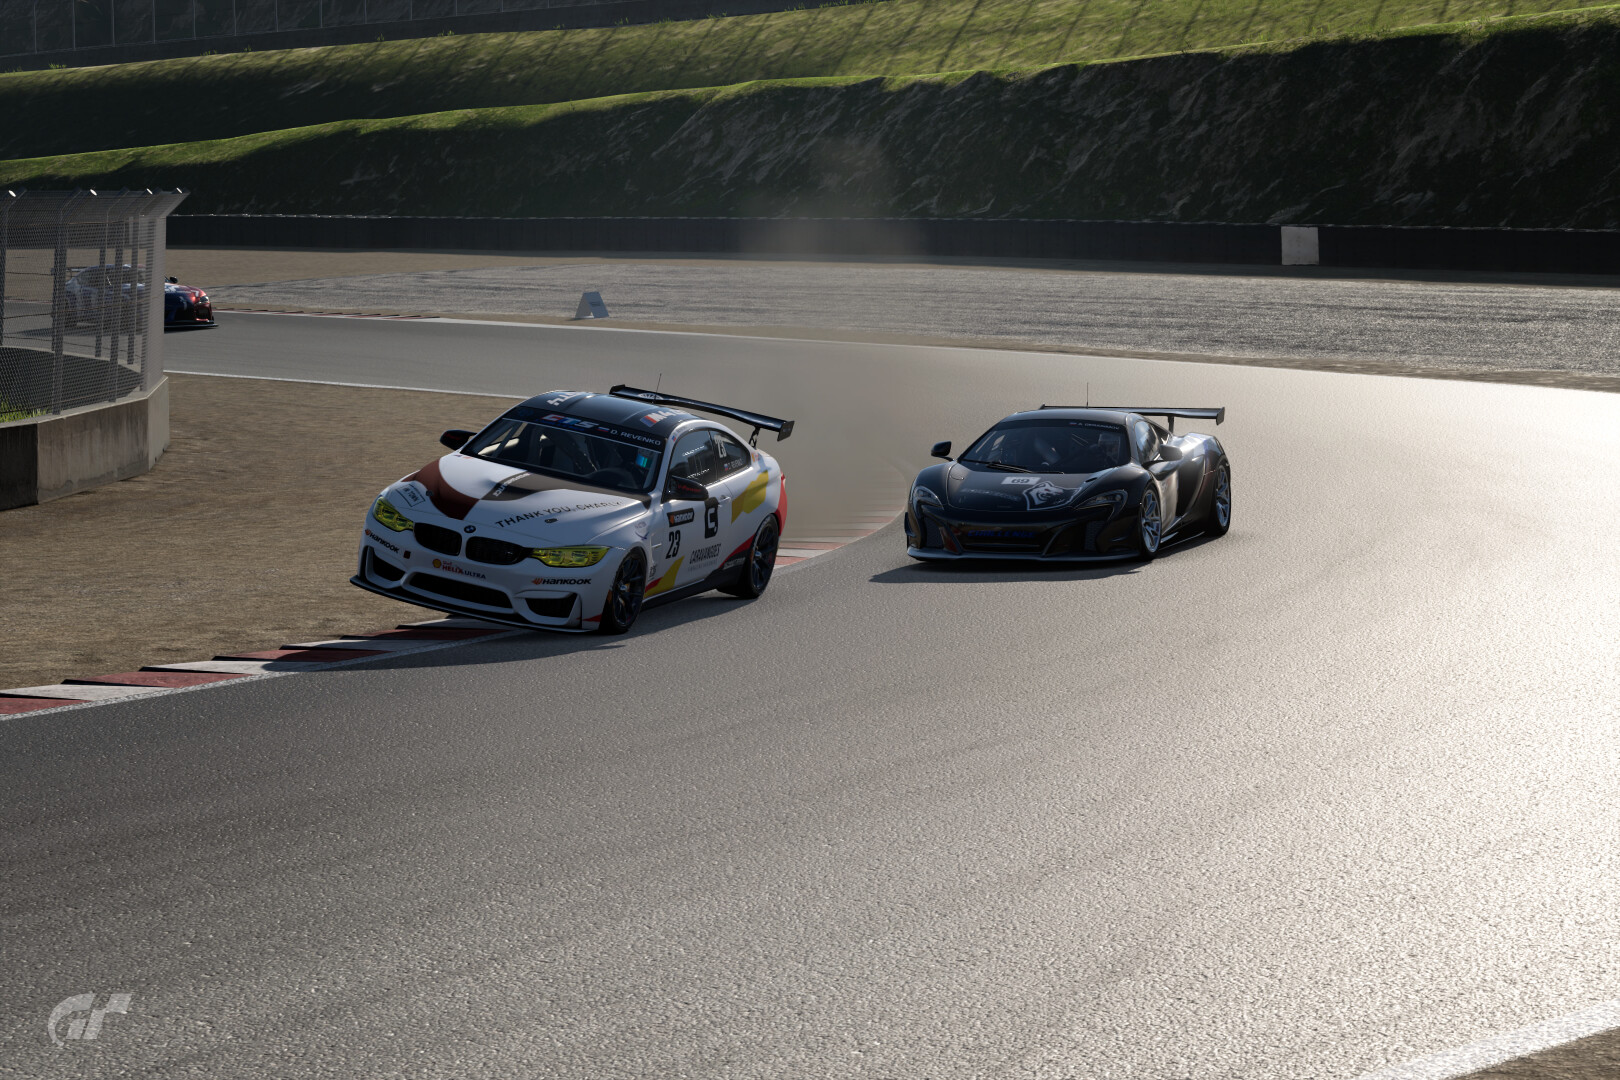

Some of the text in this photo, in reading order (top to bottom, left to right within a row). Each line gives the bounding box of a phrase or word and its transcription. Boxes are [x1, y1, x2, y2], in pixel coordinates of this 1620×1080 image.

[541, 413, 599, 429] GTS
[620, 431, 661, 446] REVENKO
[496, 510, 544, 528] THANK
[665, 530, 681, 560] 23
[464, 570, 487, 580] ULTRA
